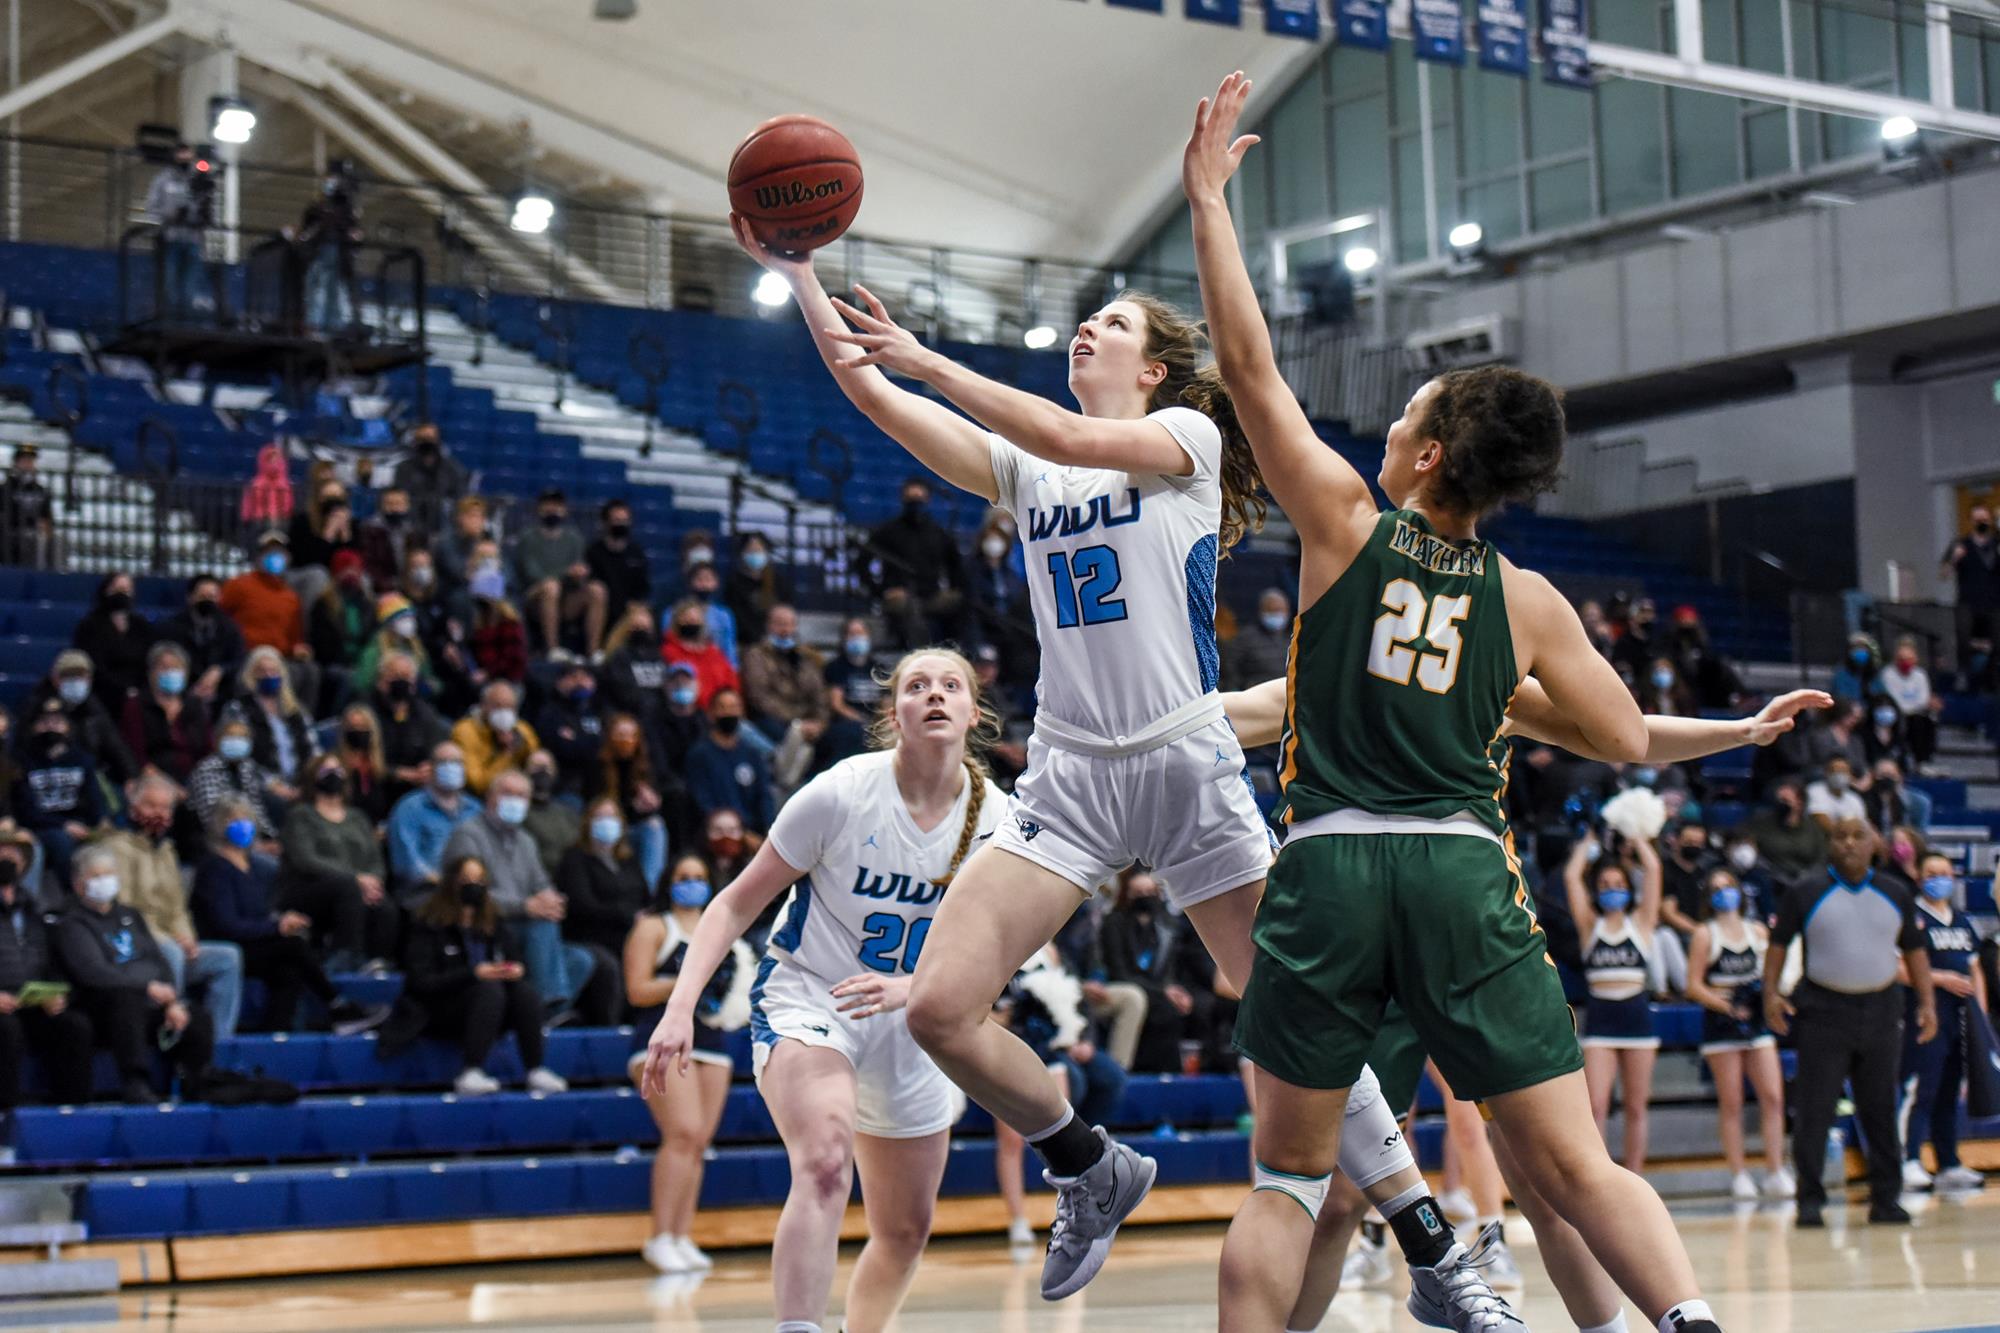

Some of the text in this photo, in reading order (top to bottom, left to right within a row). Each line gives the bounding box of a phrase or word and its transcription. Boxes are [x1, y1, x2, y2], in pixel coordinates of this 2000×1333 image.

[753, 178, 844, 209] Wilson
[1028, 487, 1143, 542] WWU
[1047, 544, 1128, 629] 12
[1367, 578, 1472, 695] 25
[852, 865, 950, 905] WW
